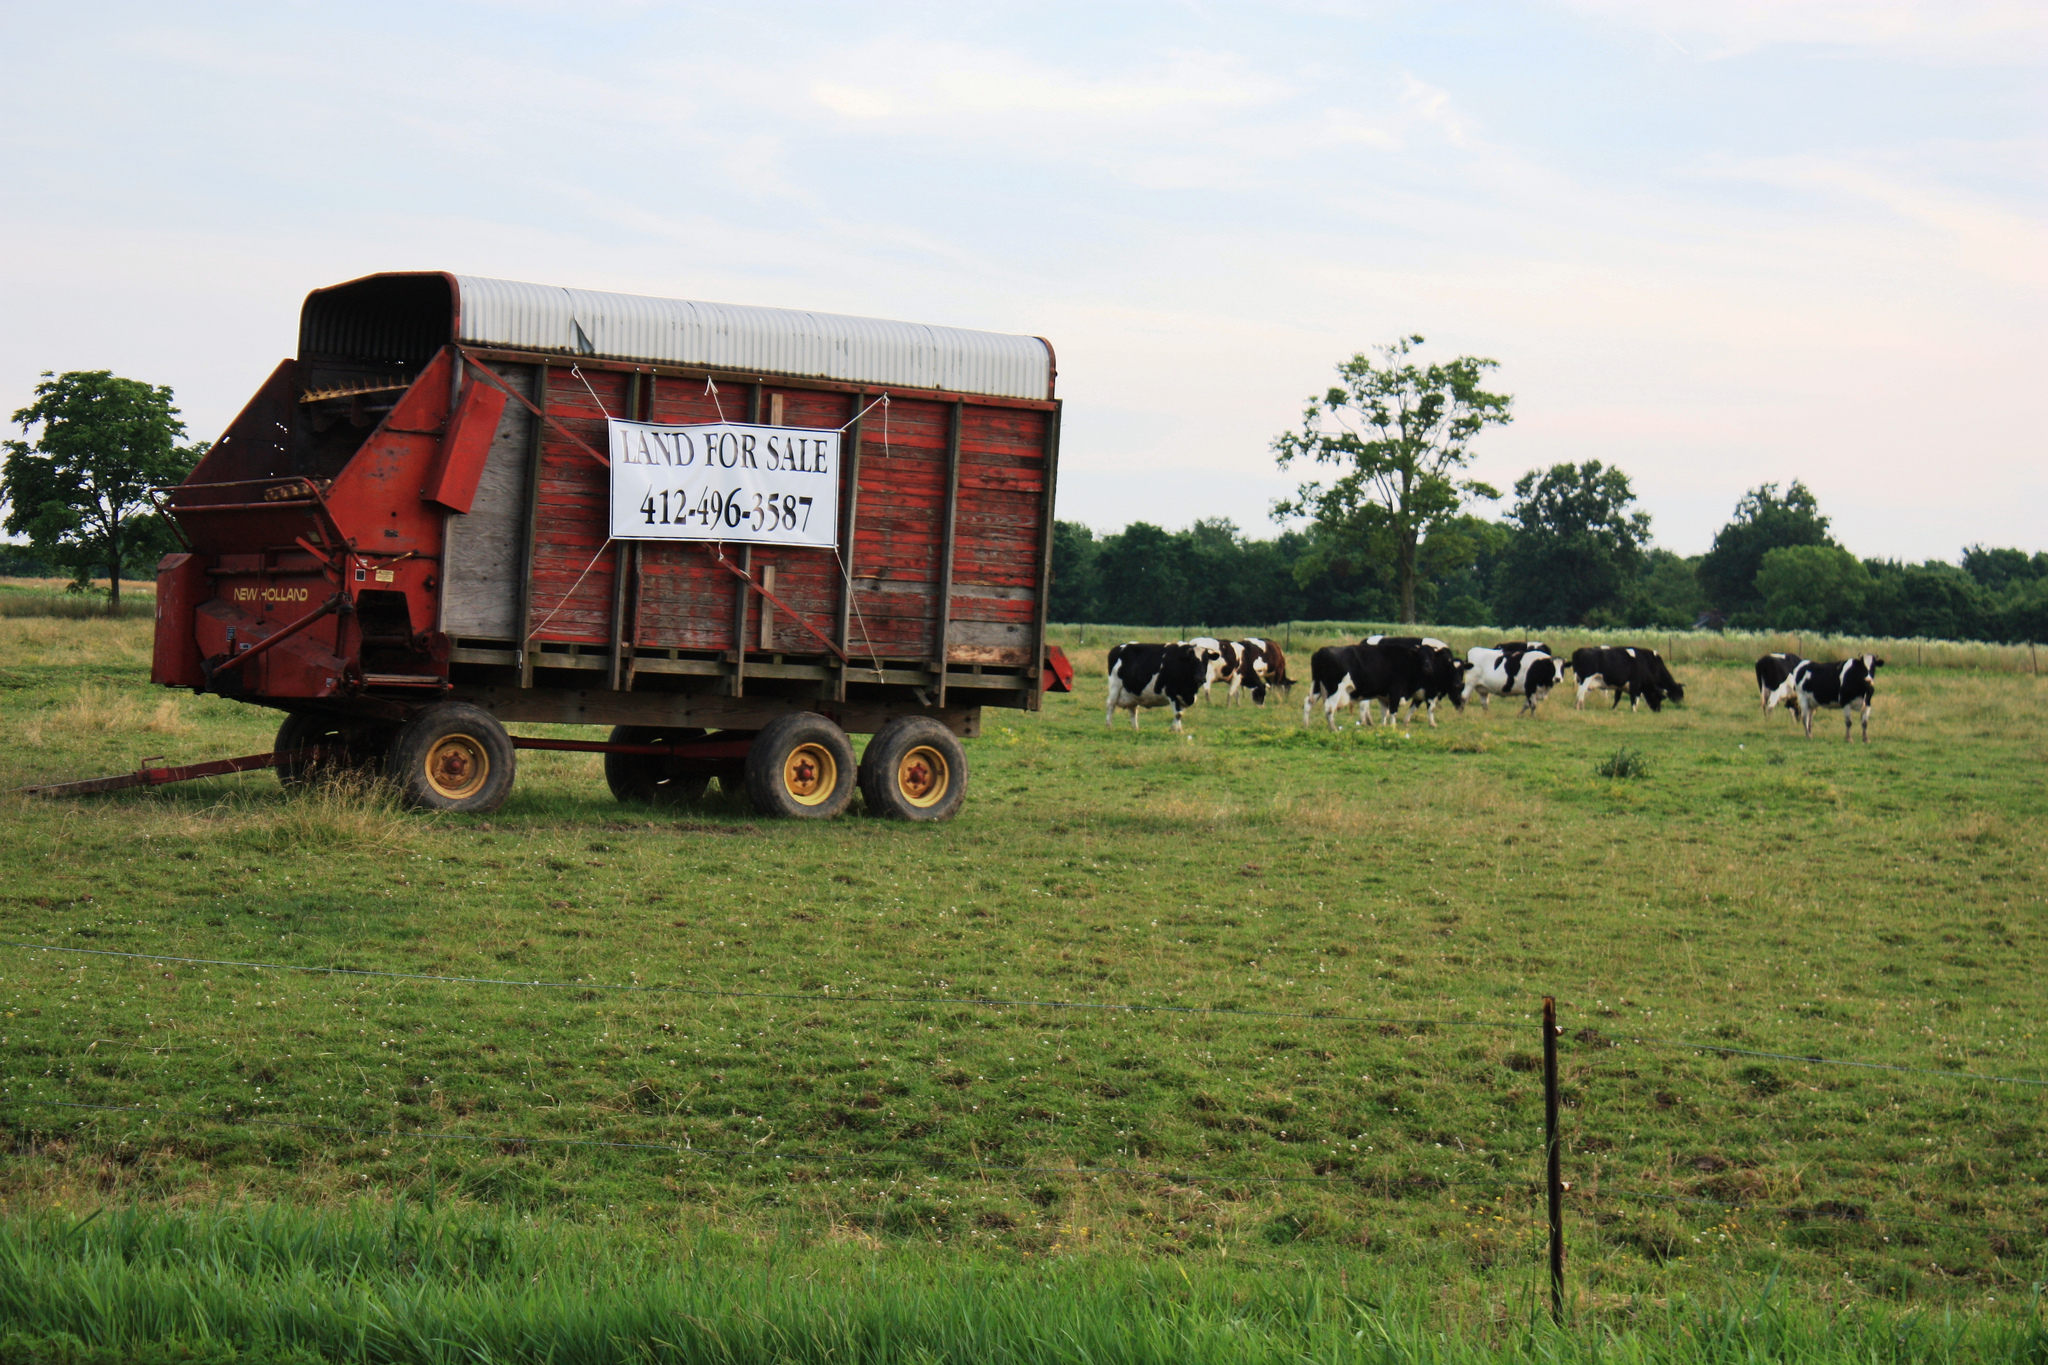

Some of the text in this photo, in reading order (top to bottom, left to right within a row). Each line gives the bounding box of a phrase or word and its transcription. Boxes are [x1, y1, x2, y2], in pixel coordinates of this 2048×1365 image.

[620, 430, 828, 474] LAND FOR SALE
[640, 484, 813, 532] 412-496-3587
[234, 588, 308, 601] NEW HOLLAND
